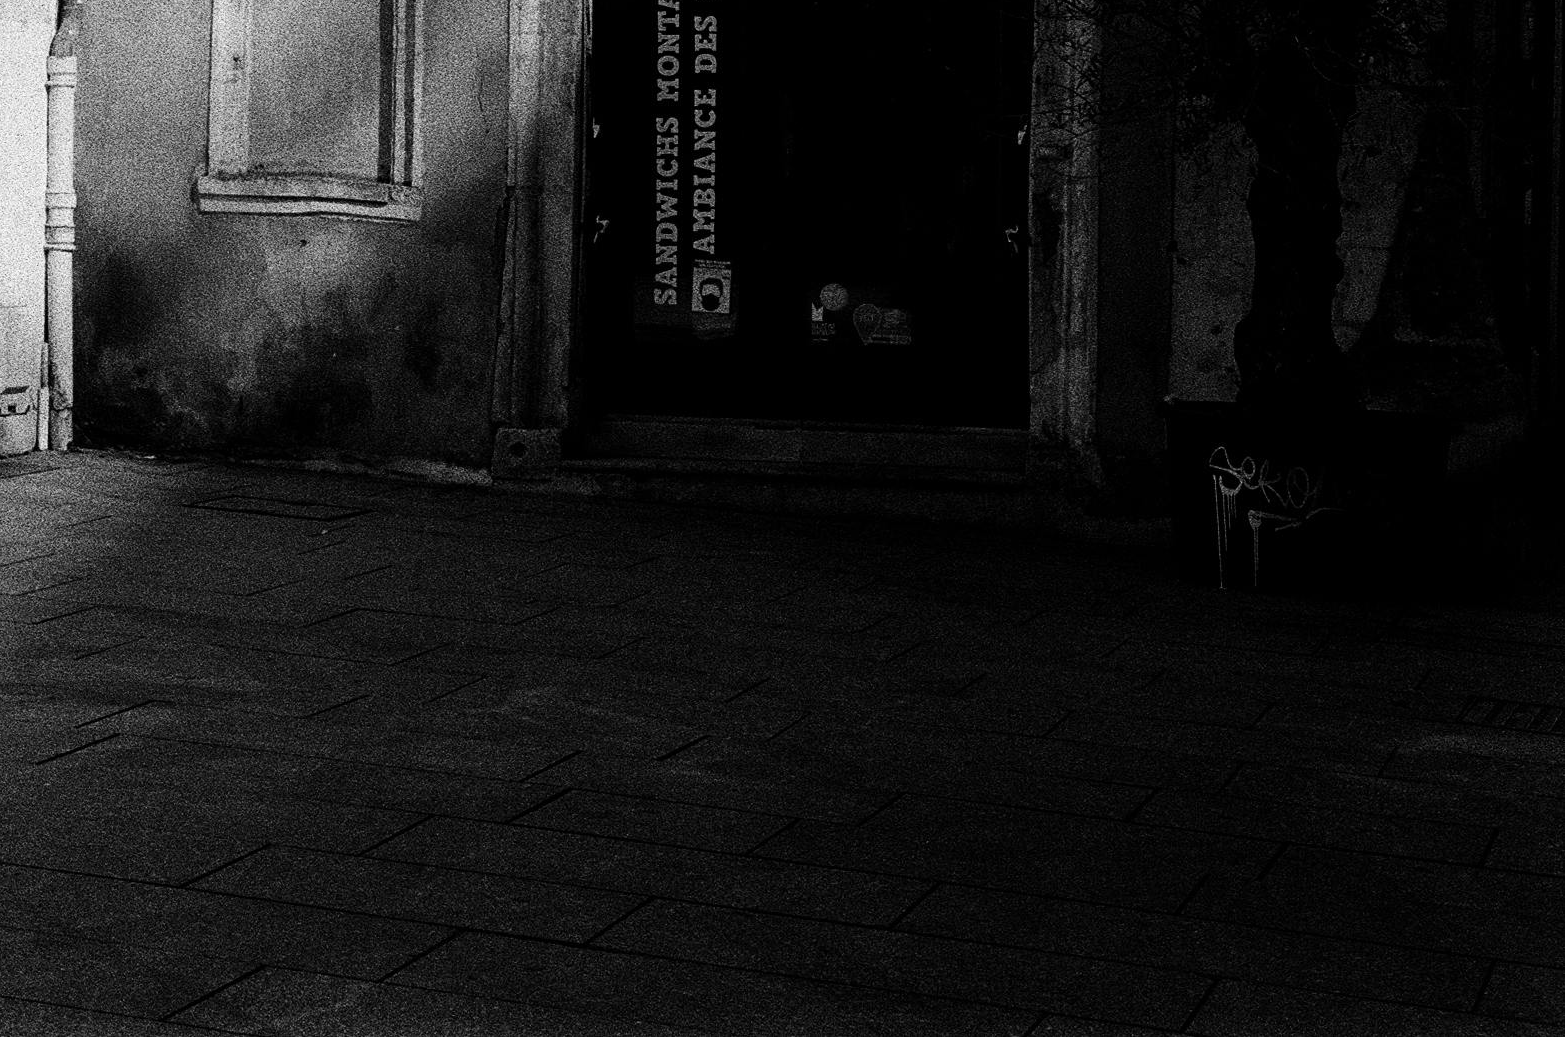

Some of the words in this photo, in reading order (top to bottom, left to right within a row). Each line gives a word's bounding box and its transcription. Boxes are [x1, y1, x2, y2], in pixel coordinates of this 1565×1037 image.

[694, 16, 718, 73] DES
[653, 117, 679, 305] SANDWICHS
[693, 89, 717, 254] AMBIANCE
